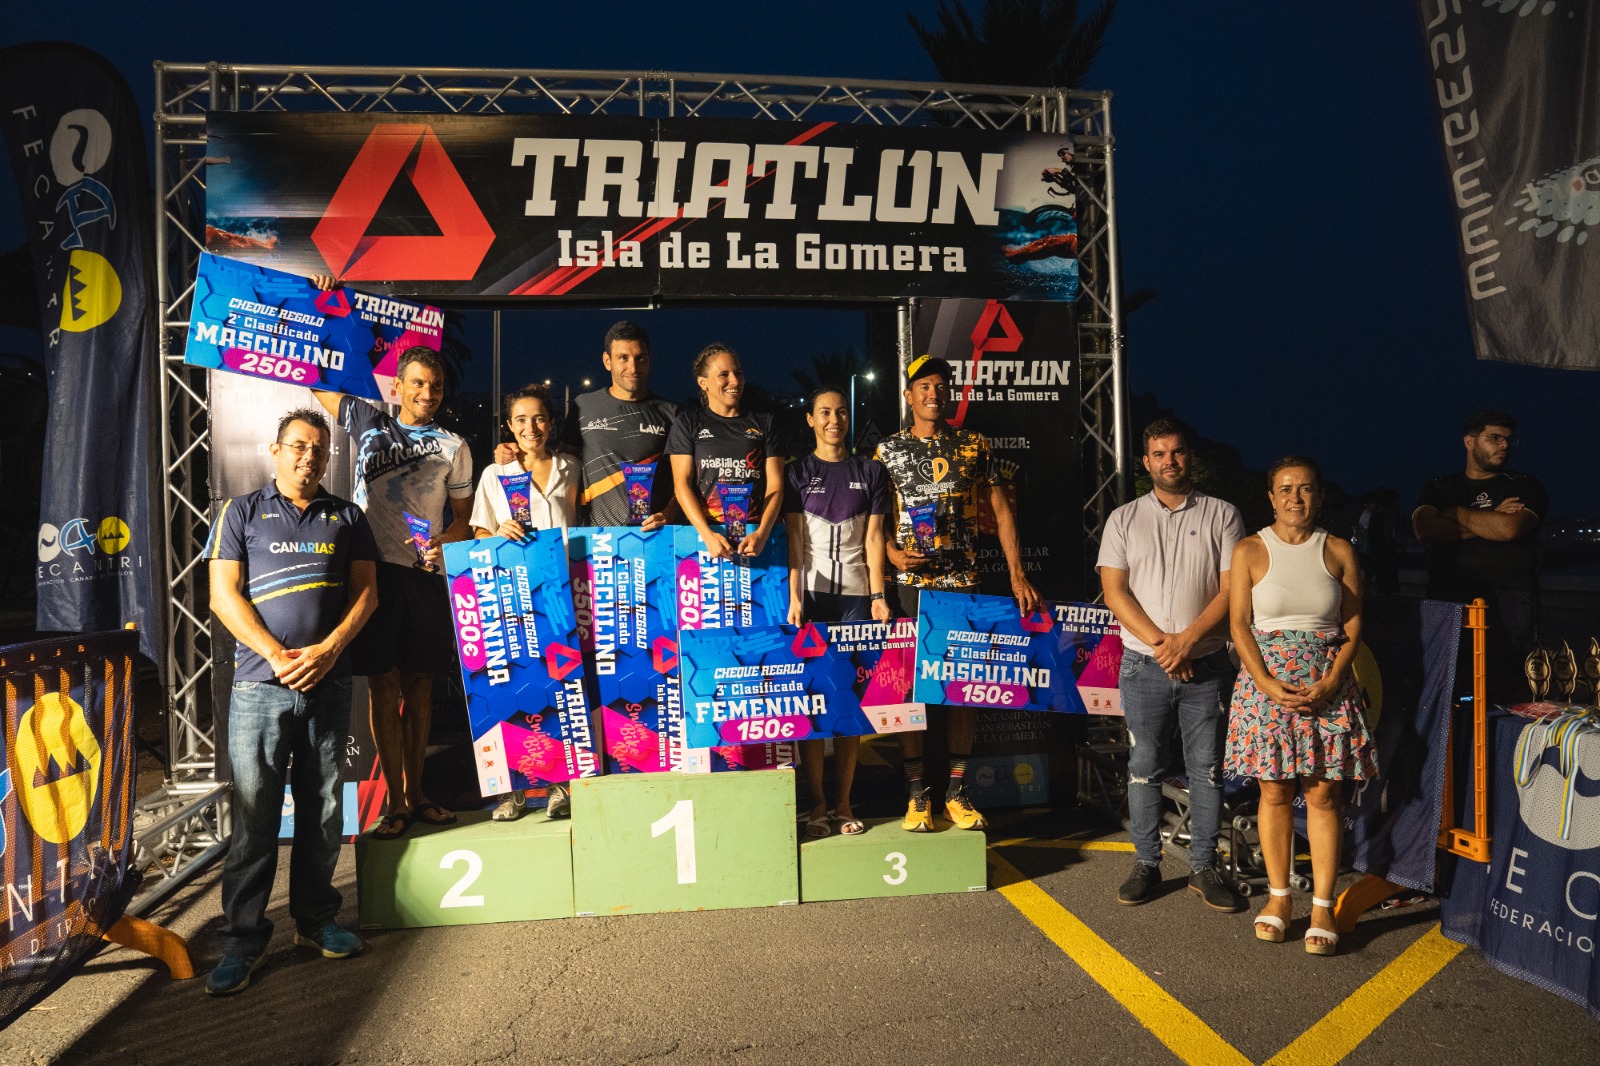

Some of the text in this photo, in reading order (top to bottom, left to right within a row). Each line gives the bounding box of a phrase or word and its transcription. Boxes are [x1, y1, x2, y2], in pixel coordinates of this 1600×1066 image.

[557, 229, 967, 274] Isla de La Gomera
[228, 297, 325, 328] CHEQUE REGALO
[360, 312, 439, 336] Isla de La Gomera
[194, 321, 345, 371] MASCULINO
[243, 317, 320, 343] Clasificado
[239, 353, 307, 381] 250€
[967, 388, 984, 401] de
[987, 388, 1004, 402] La
[1007, 388, 1060, 402] Gomera
[269, 541, 336, 555] CANARIAS
[38, 555, 143, 579] ECANTRI
[572, 577, 594, 641] 350€
[592, 532, 616, 676] MASCULINO
[617, 572, 630, 645] Clasificado
[633, 557, 648, 650] CHEQUE REGALO
[723, 569, 735, 627] Clasifica
[739, 557, 753, 628] CHEQUE REG
[453, 593, 481, 658] 250€
[469, 548, 511, 687] FEMENINA
[500, 581, 521, 660] Clasificada
[515, 565, 540, 659] CHEQUE REGALO
[1055, 605, 1120, 626] TRIATL
[946, 629, 1031, 647] CHEQUE REGALO
[1062, 623, 1120, 636] Isla de La Gom
[837, 640, 915, 653] Isla de La Gomera
[961, 647, 1027, 663] Clasificado
[713, 663, 805, 680] CHEQUE REGALO
[856, 658, 892, 684] Swim
[876, 667, 906, 688] Bike
[921, 659, 1050, 688] MASCULINO
[731, 681, 804, 696] Clasificada
[961, 683, 1014, 705] 150€
[624, 702, 650, 742] Swim
[695, 694, 828, 723] FEMENINA
[525, 713, 554, 751] Swim
[554, 690, 576, 776] Isla de La Gomera
[619, 722, 640, 756] Bike
[657, 684, 666, 768] Isla de La Gomera
[737, 719, 795, 741] 150€
[522, 735, 547, 769] Bike
[612, 741, 631, 773] Run
[518, 754, 540, 787] Run
[650, 799, 697, 885] 1
[439, 849, 485, 908] 2
[882, 851, 908, 885] 3
